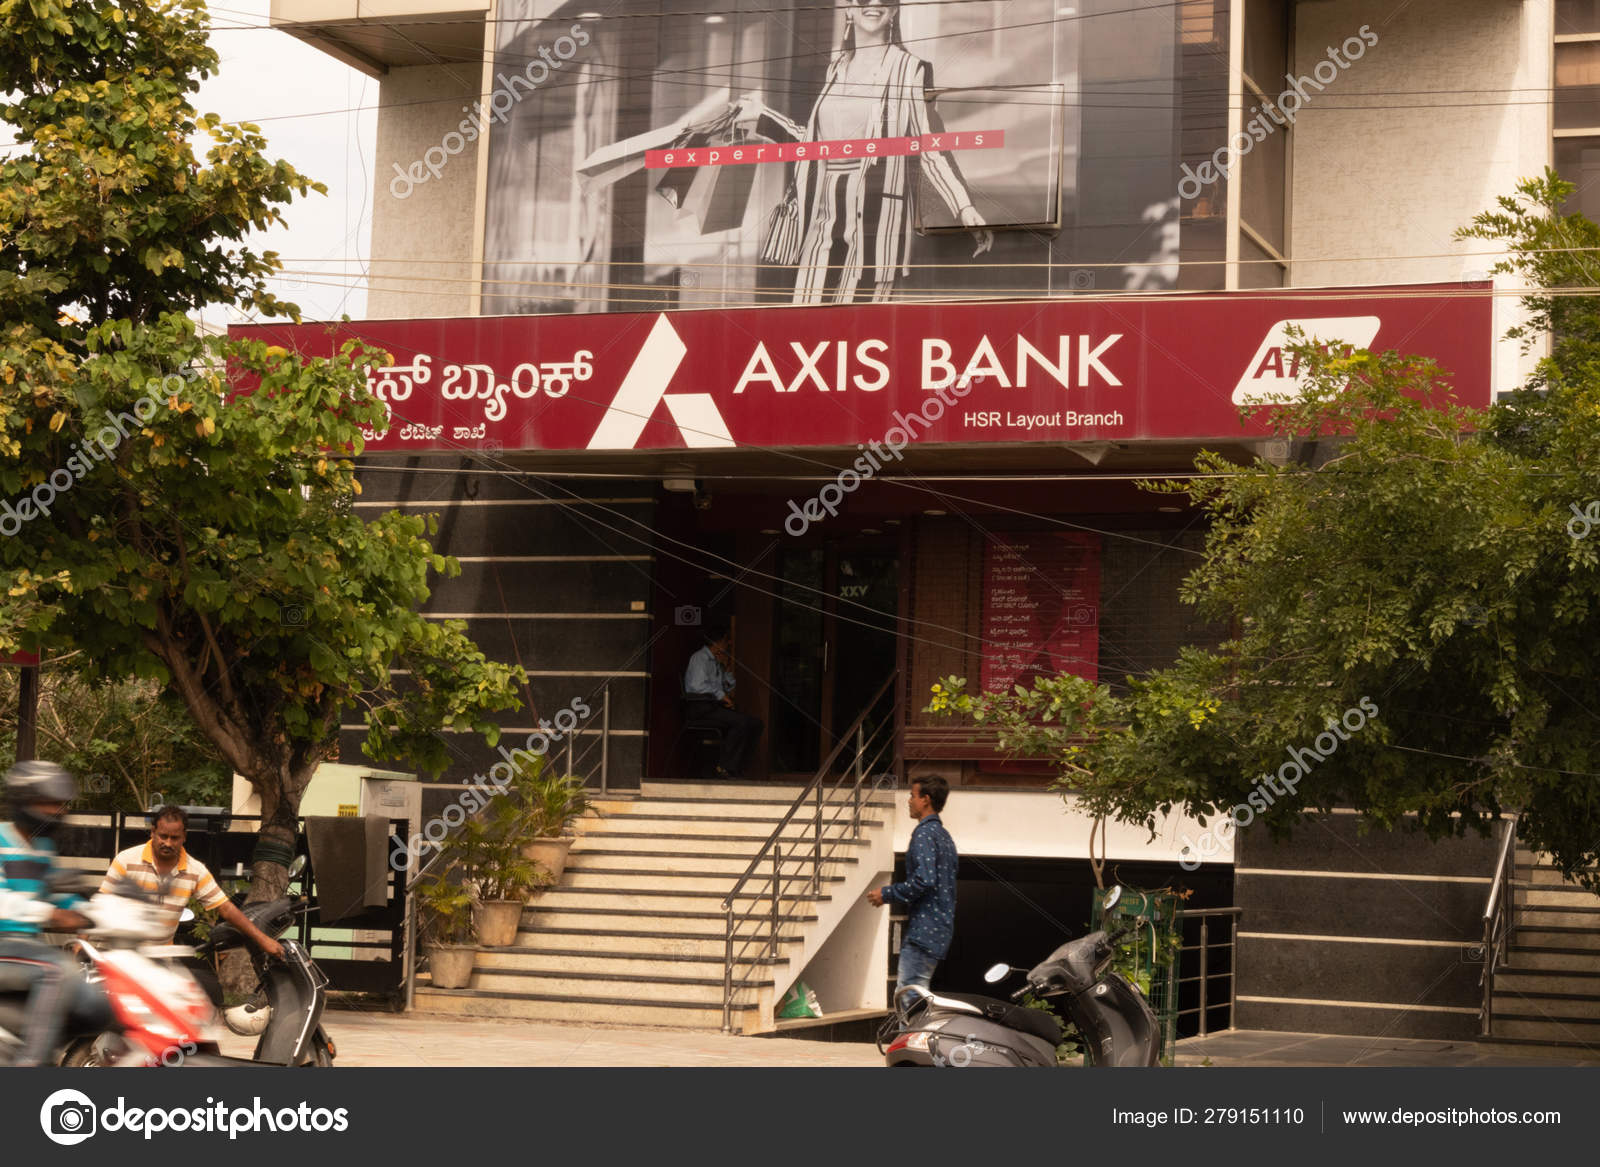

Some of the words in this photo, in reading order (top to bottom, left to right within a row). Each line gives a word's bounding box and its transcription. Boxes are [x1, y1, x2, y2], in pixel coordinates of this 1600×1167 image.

[664, 141, 877, 163] experience
[910, 134, 984, 152] axis
[441, 350, 594, 421] ಬ್ಯಾಂಕ್
[733, 339, 890, 394] AXIS
[921, 334, 1124, 390] BANK
[964, 411, 1002, 428] HSR
[1006, 412, 1061, 431] Layout
[1065, 410, 1124, 427] Branch
